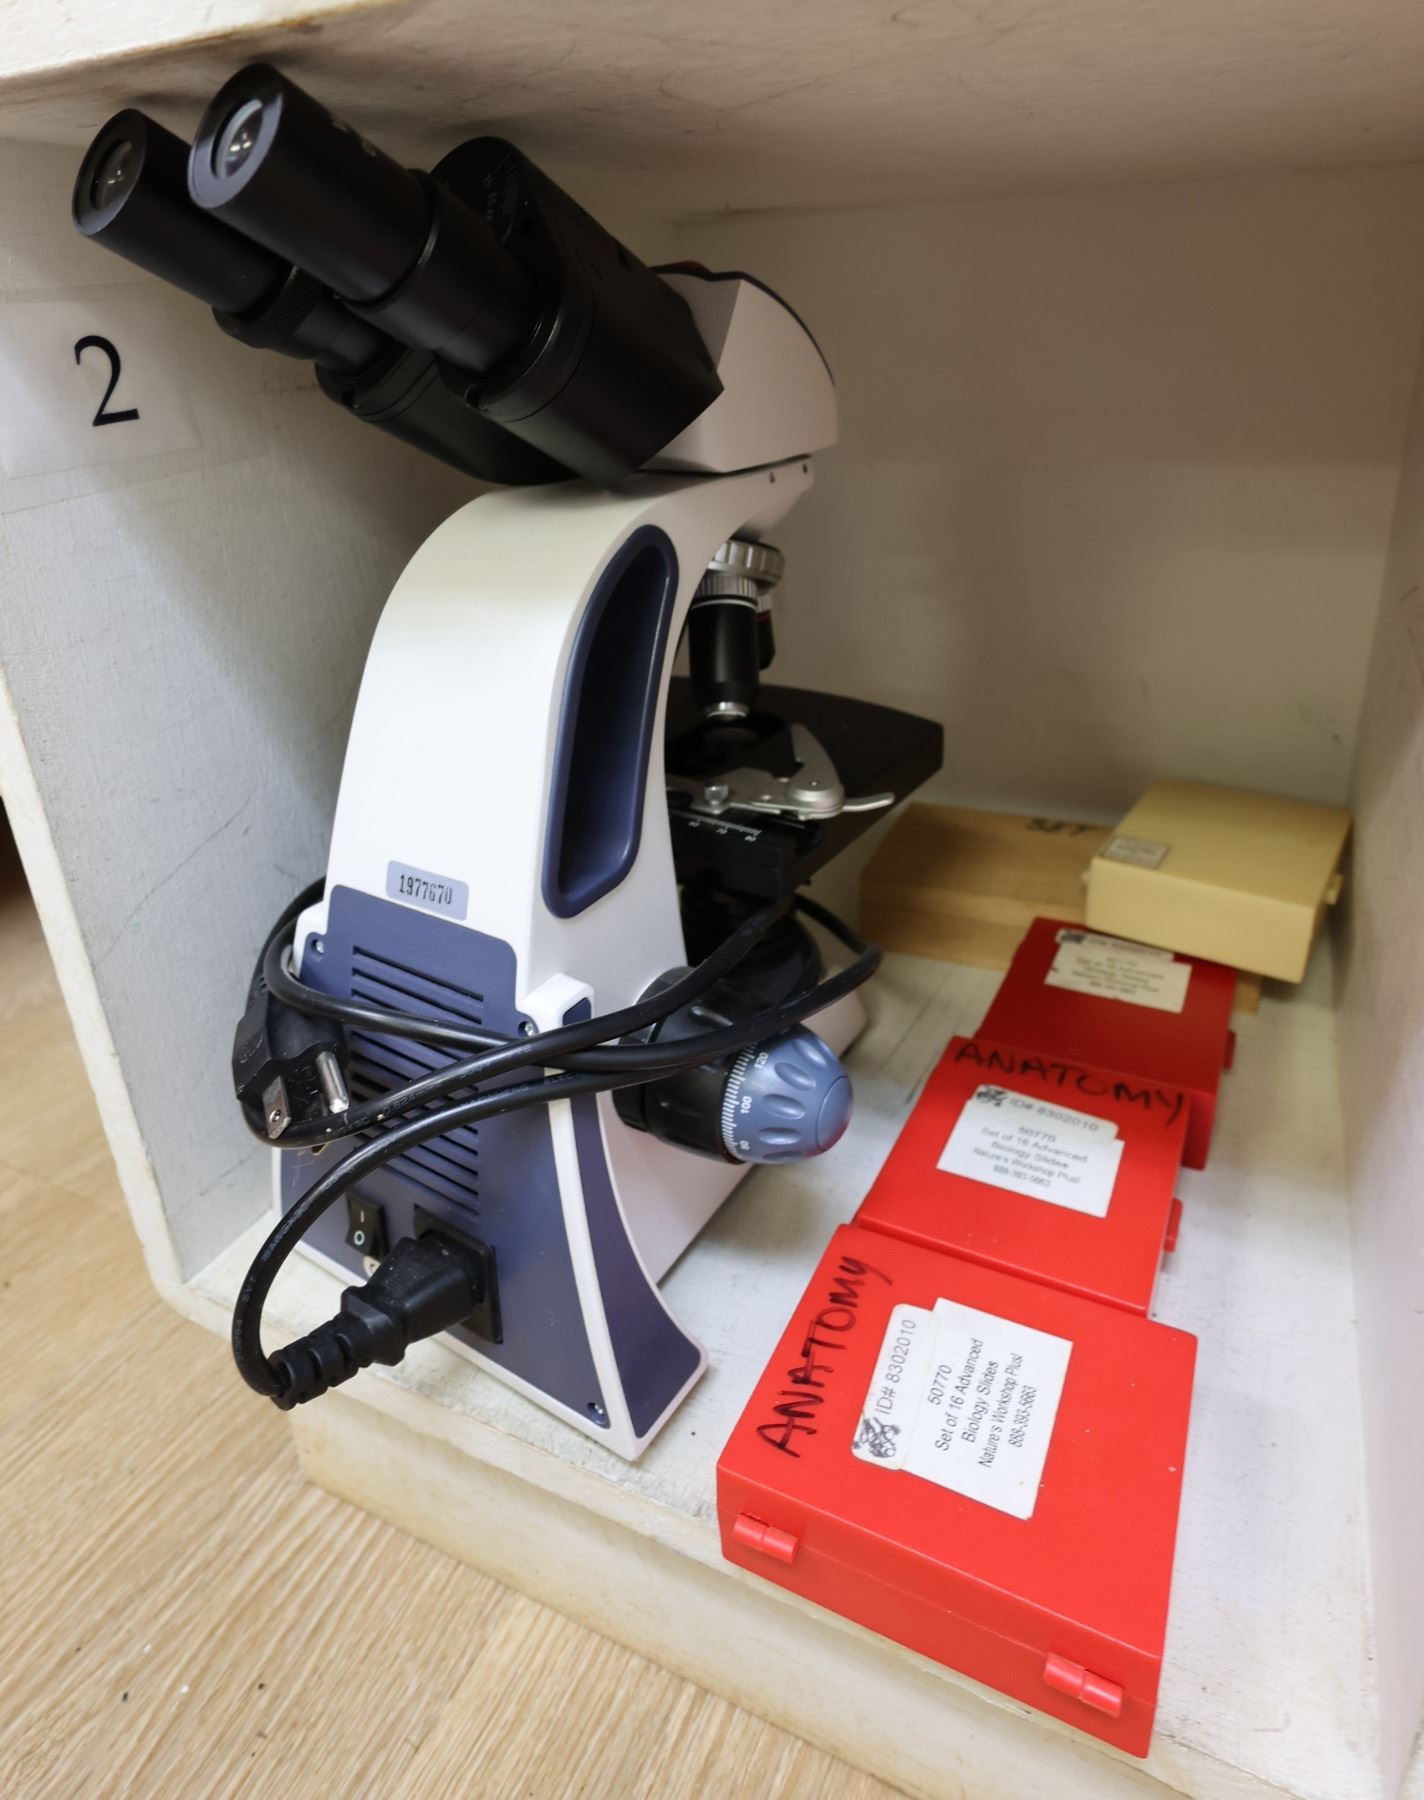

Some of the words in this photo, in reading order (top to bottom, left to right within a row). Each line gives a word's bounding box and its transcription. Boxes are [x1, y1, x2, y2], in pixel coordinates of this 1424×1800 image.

[74, 335, 140, 427] 2
[399, 874, 453, 905] 1977670
[955, 1042, 1184, 1128] ANATOMY
[740, 1096, 752, 1114] 100
[1036, 1107, 1099, 1132] 8302010
[1018, 1126, 1057, 1143] 50770
[756, 1256, 893, 1458] ANATOMY
[885, 1319, 917, 1384] 8302010
[954, 1337, 984, 1396] Advanced
[875, 1385, 897, 1415] ID#
[927, 1364, 952, 1406] 50770
[948, 1395, 965, 1410] 16
[961, 1397, 990, 1444] Biology
[976, 1360, 999, 1396] Slides
[990, 1376, 1018, 1423] Workshop
[945, 1411, 959, 1428] of
[934, 1428, 955, 1452] Set
